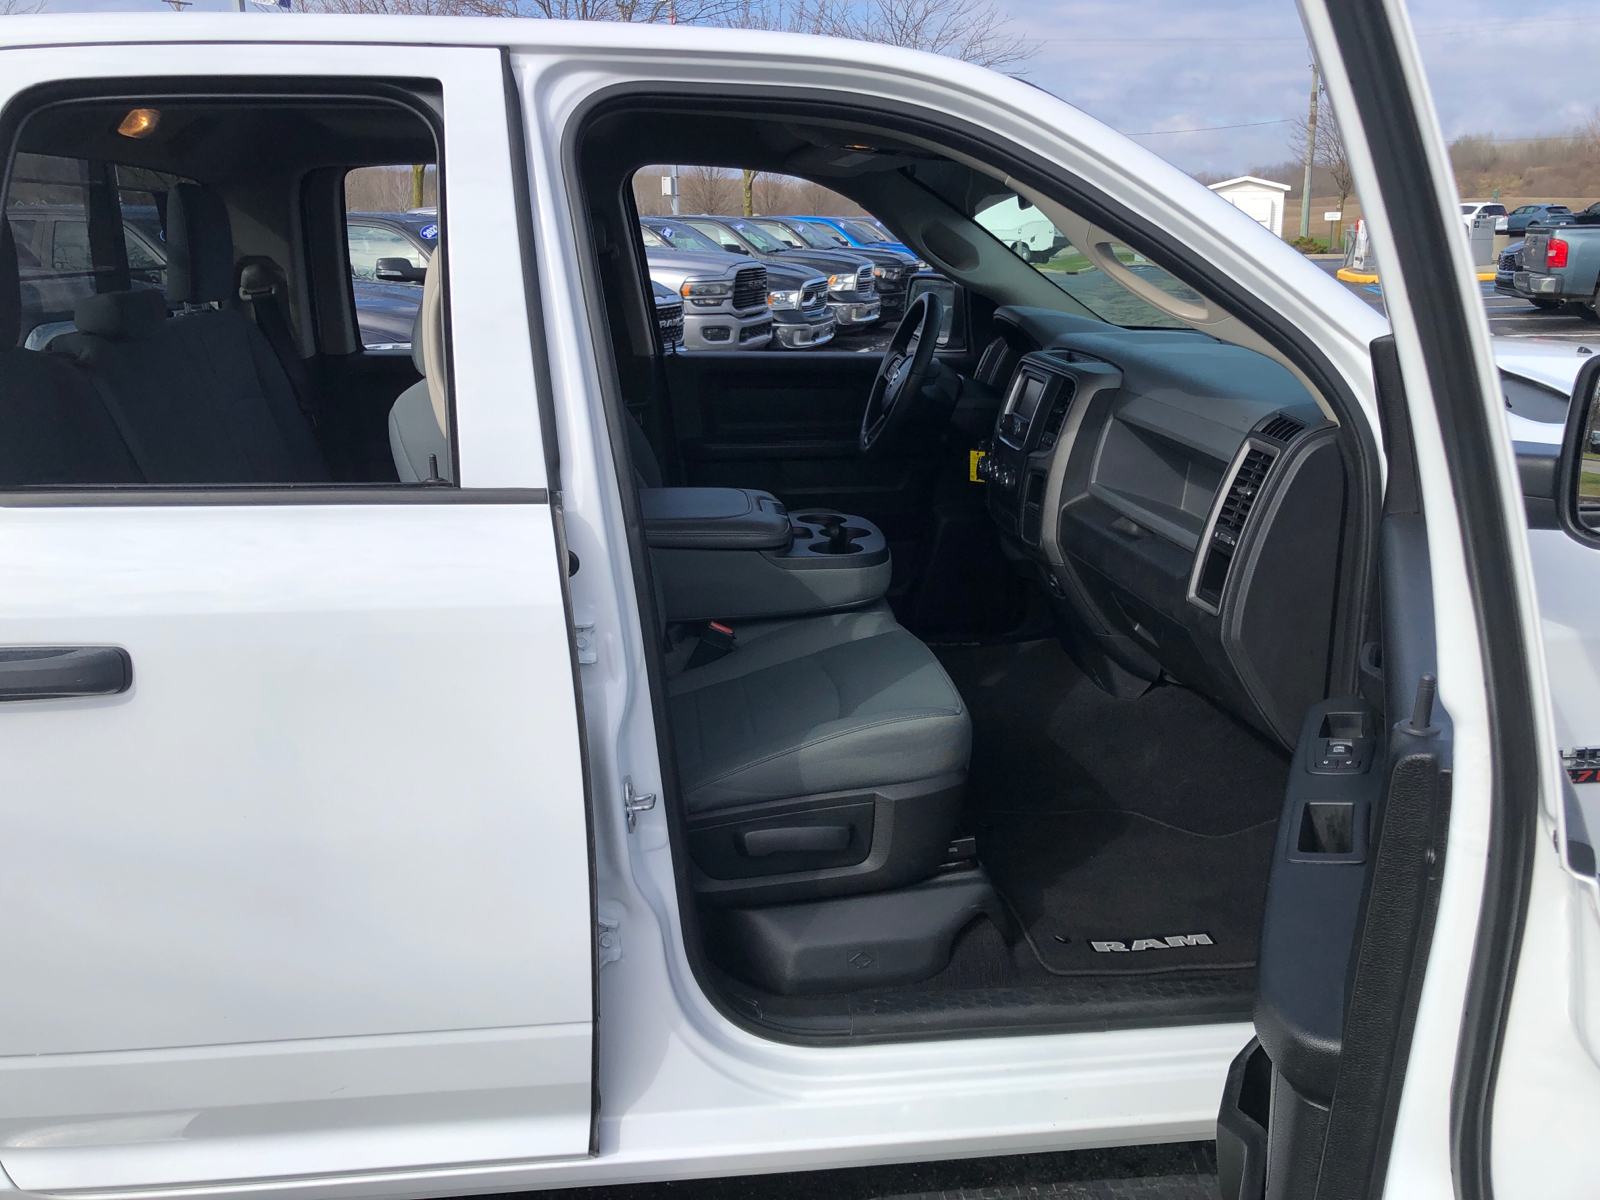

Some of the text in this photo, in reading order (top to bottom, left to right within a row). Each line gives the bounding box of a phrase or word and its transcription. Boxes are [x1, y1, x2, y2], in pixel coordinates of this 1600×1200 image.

[659, 318, 681, 328] RAM
[1567, 770, 1594, 782] .7
[1091, 934, 1214, 953] RAM
